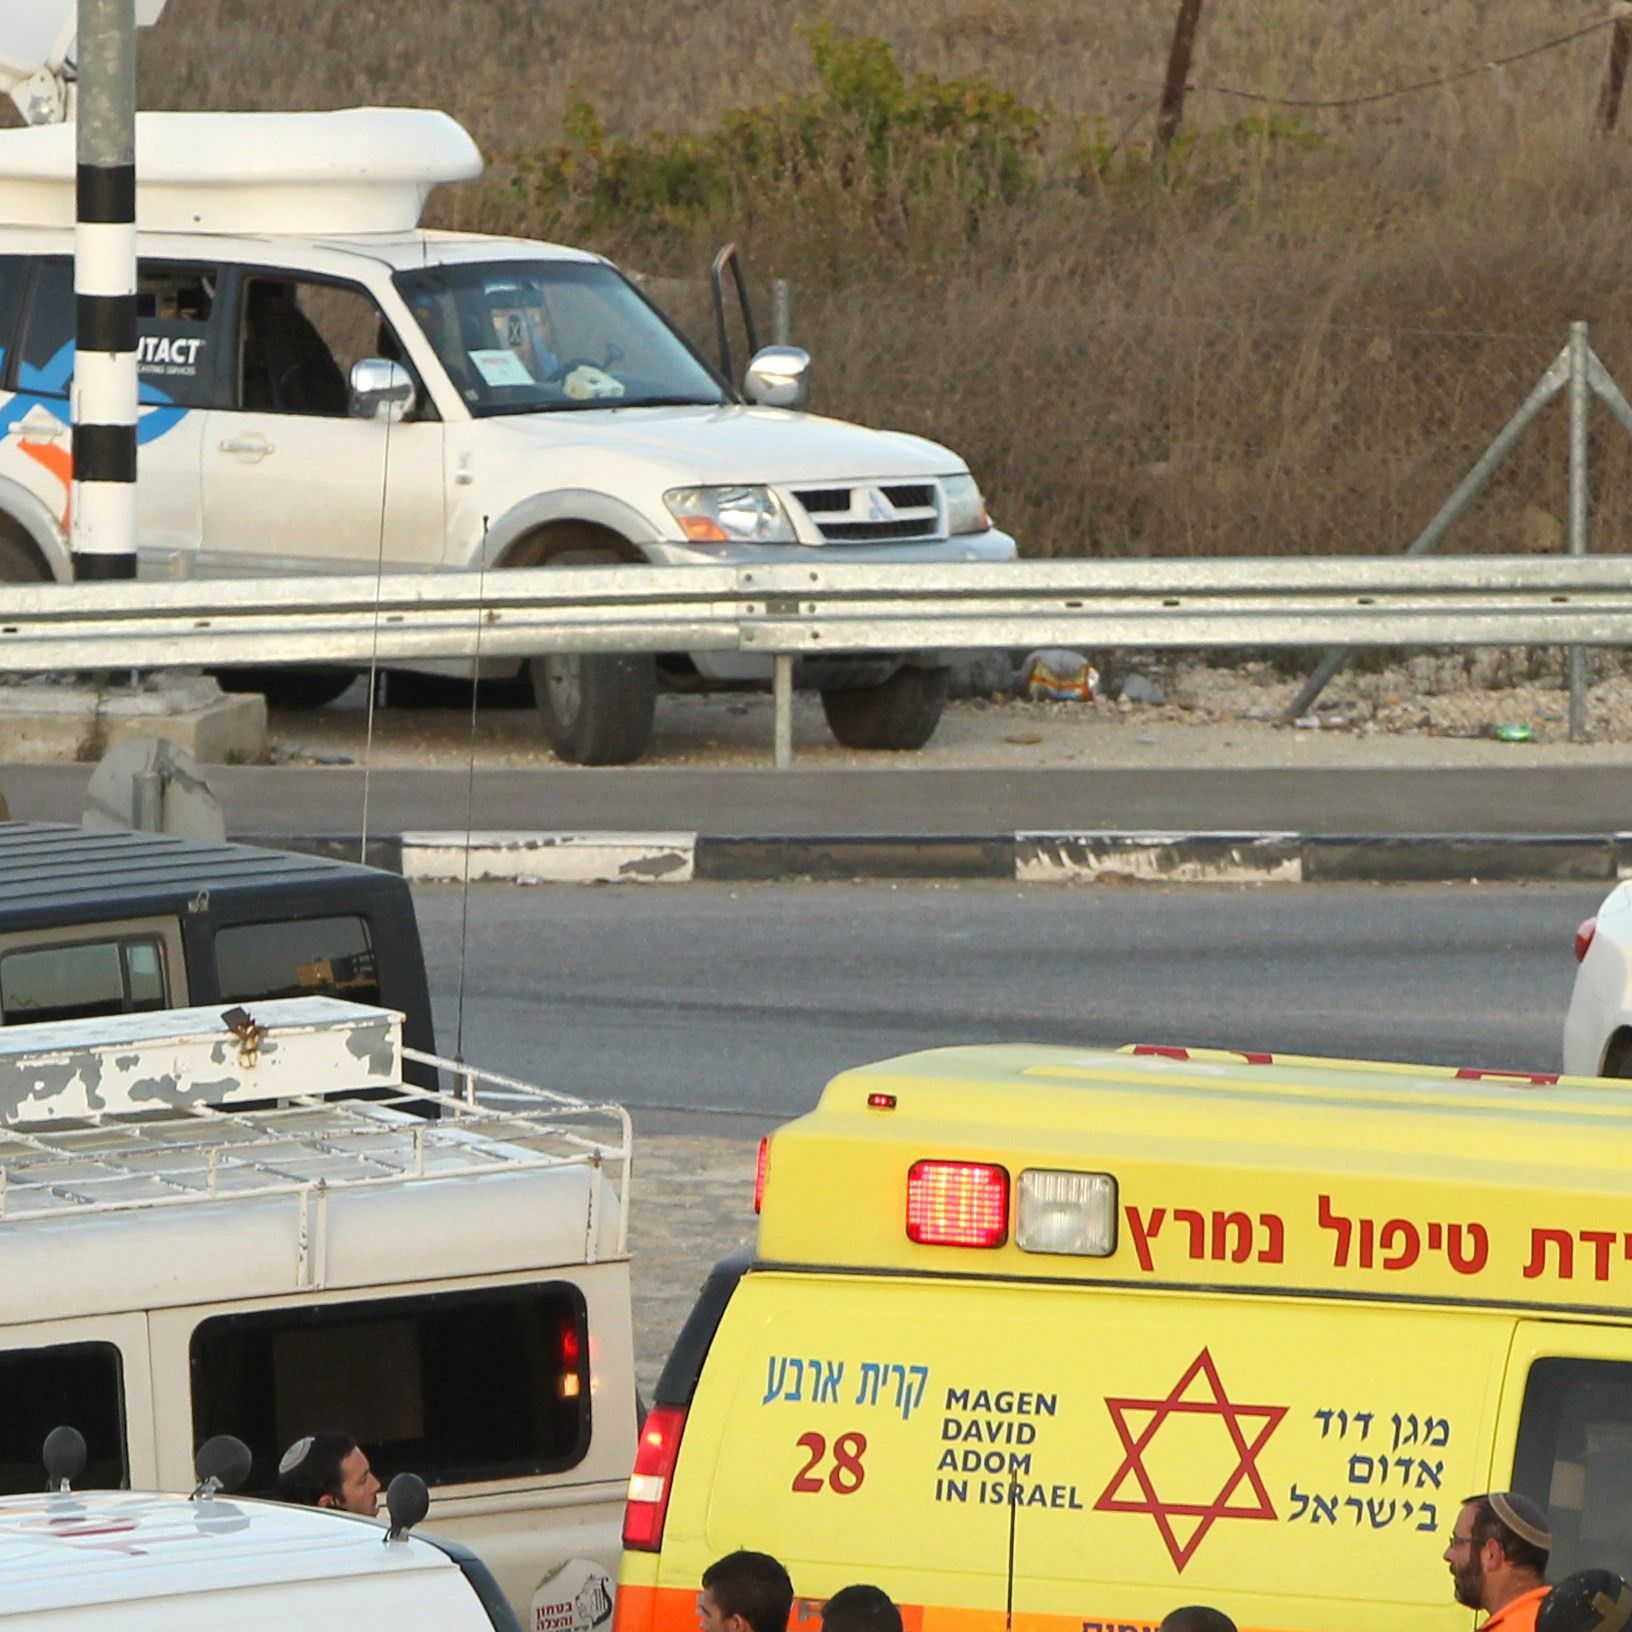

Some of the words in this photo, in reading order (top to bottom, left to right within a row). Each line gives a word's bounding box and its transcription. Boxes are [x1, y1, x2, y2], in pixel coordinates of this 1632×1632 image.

[136, 336, 200, 364] TACT
[1124, 1204, 1285, 1272] נמרץ
[1317, 1193, 1490, 1276] טיפול
[761, 1355, 845, 1406] ארבע
[855, 1361, 929, 1420] קרית
[945, 1388, 1058, 1417] MAGEN
[941, 1418, 1037, 1445] DAVID
[1313, 1407, 1374, 1441] דוד
[1392, 1412, 1451, 1450] מגן
[791, 1431, 868, 1495] 28
[937, 1448, 1032, 1475] ADOM
[1348, 1453, 1445, 1489] אדום
[935, 1478, 969, 1504] IN
[979, 1481, 1085, 1511] ISRAEL
[1288, 1484, 1440, 1533] בישראל
[536, 1601, 573, 1619] בטחון
[536, 1615, 573, 1631] והצלה
